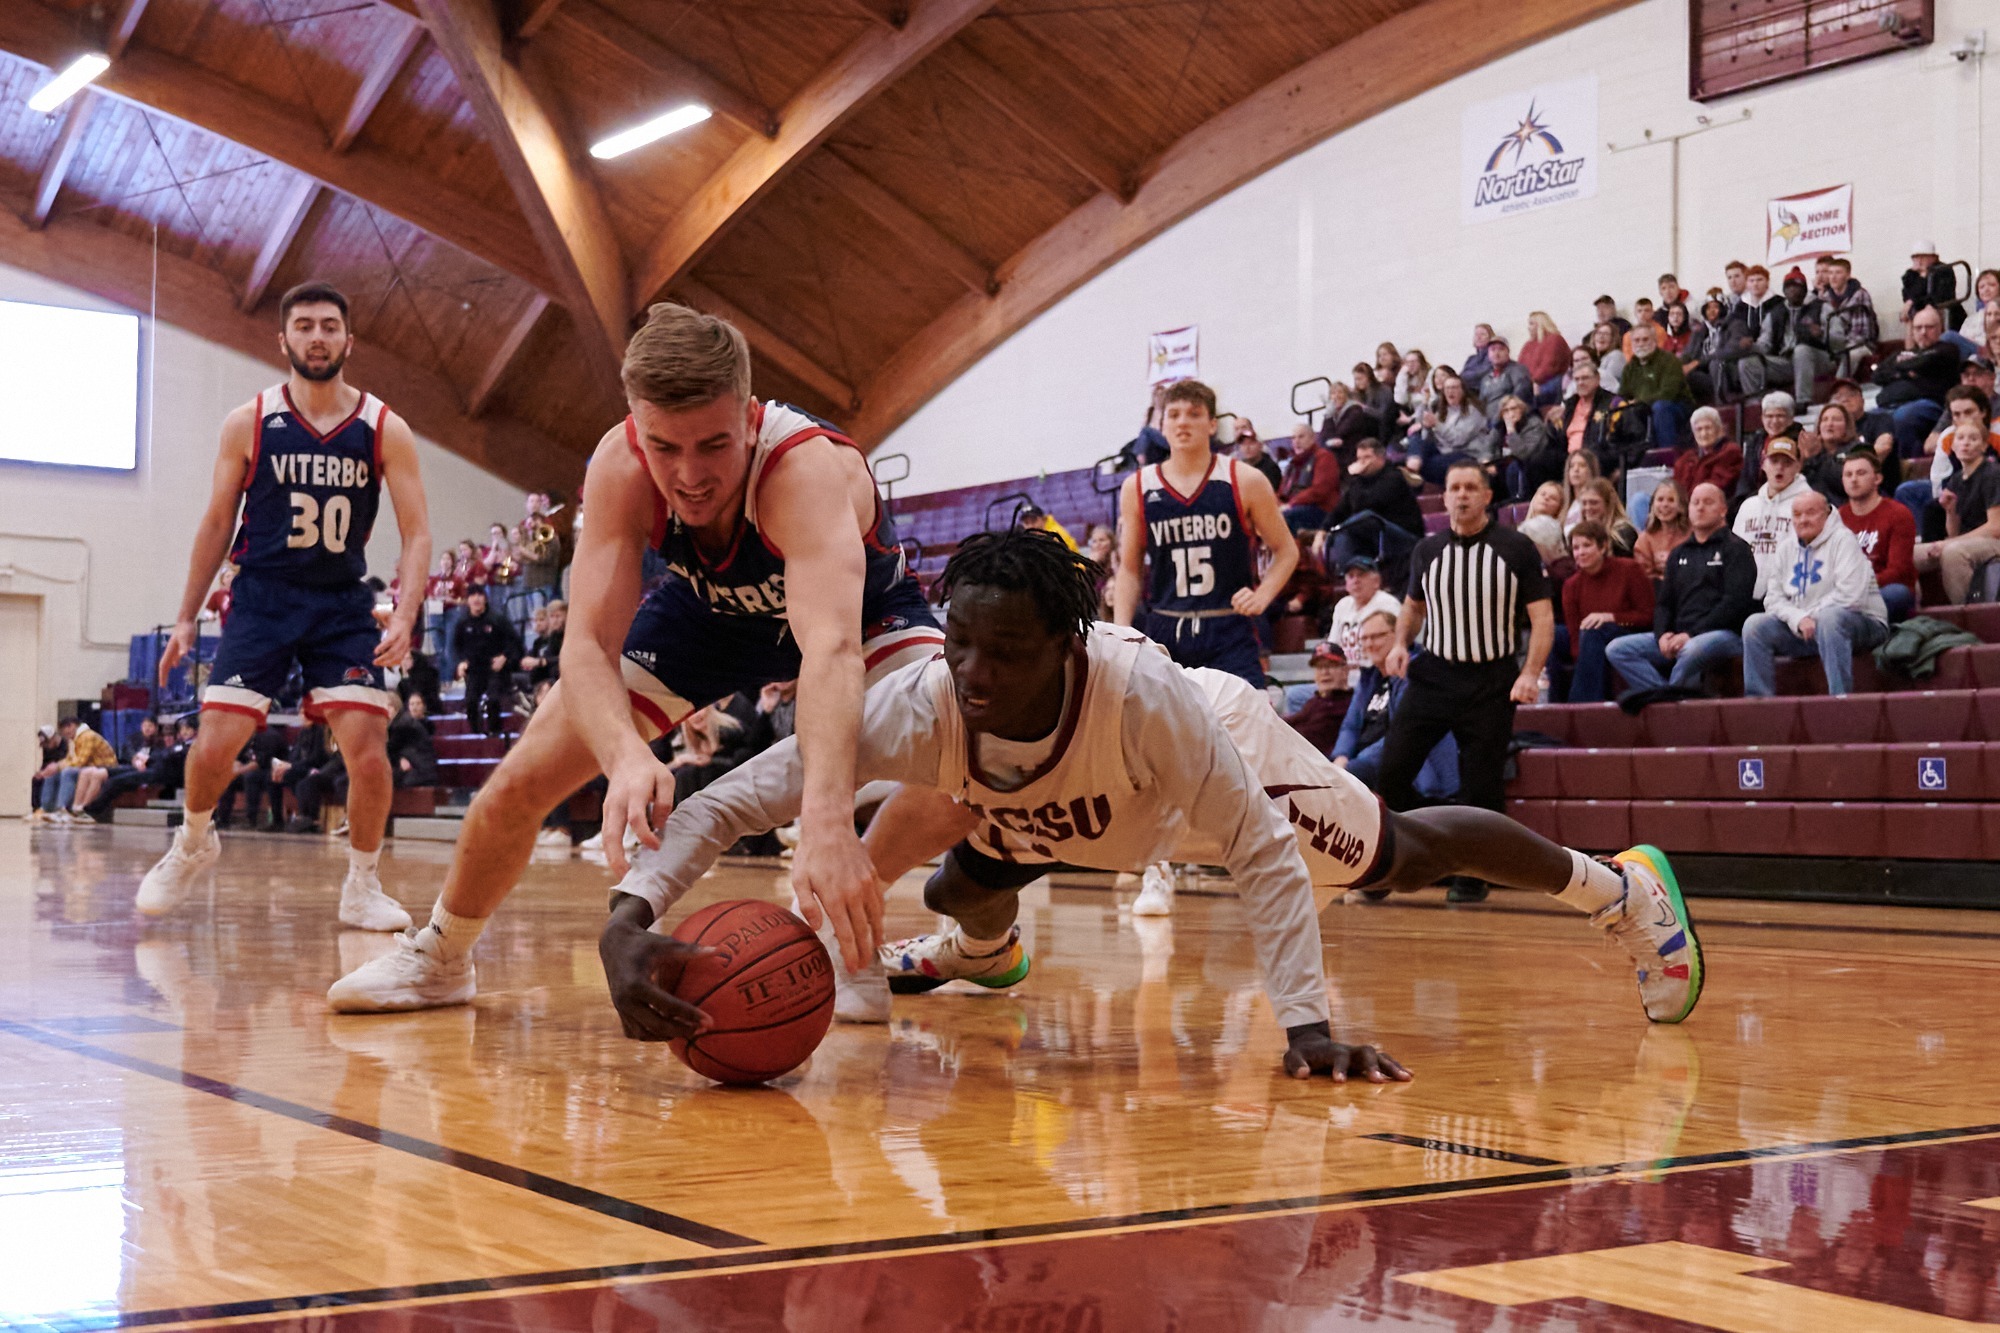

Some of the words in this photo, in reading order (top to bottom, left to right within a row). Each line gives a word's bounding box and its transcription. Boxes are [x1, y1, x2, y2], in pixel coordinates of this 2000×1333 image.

[1474, 157, 1585, 207] NorthStar
[1800, 223, 1847, 241] SECTION
[1807, 208, 1839, 223] HOME
[270, 454, 369, 488] VITERBO
[287, 492, 352, 553] 30
[1150, 512, 1231, 547] VITERBO
[1171, 546, 1215, 597] 15
